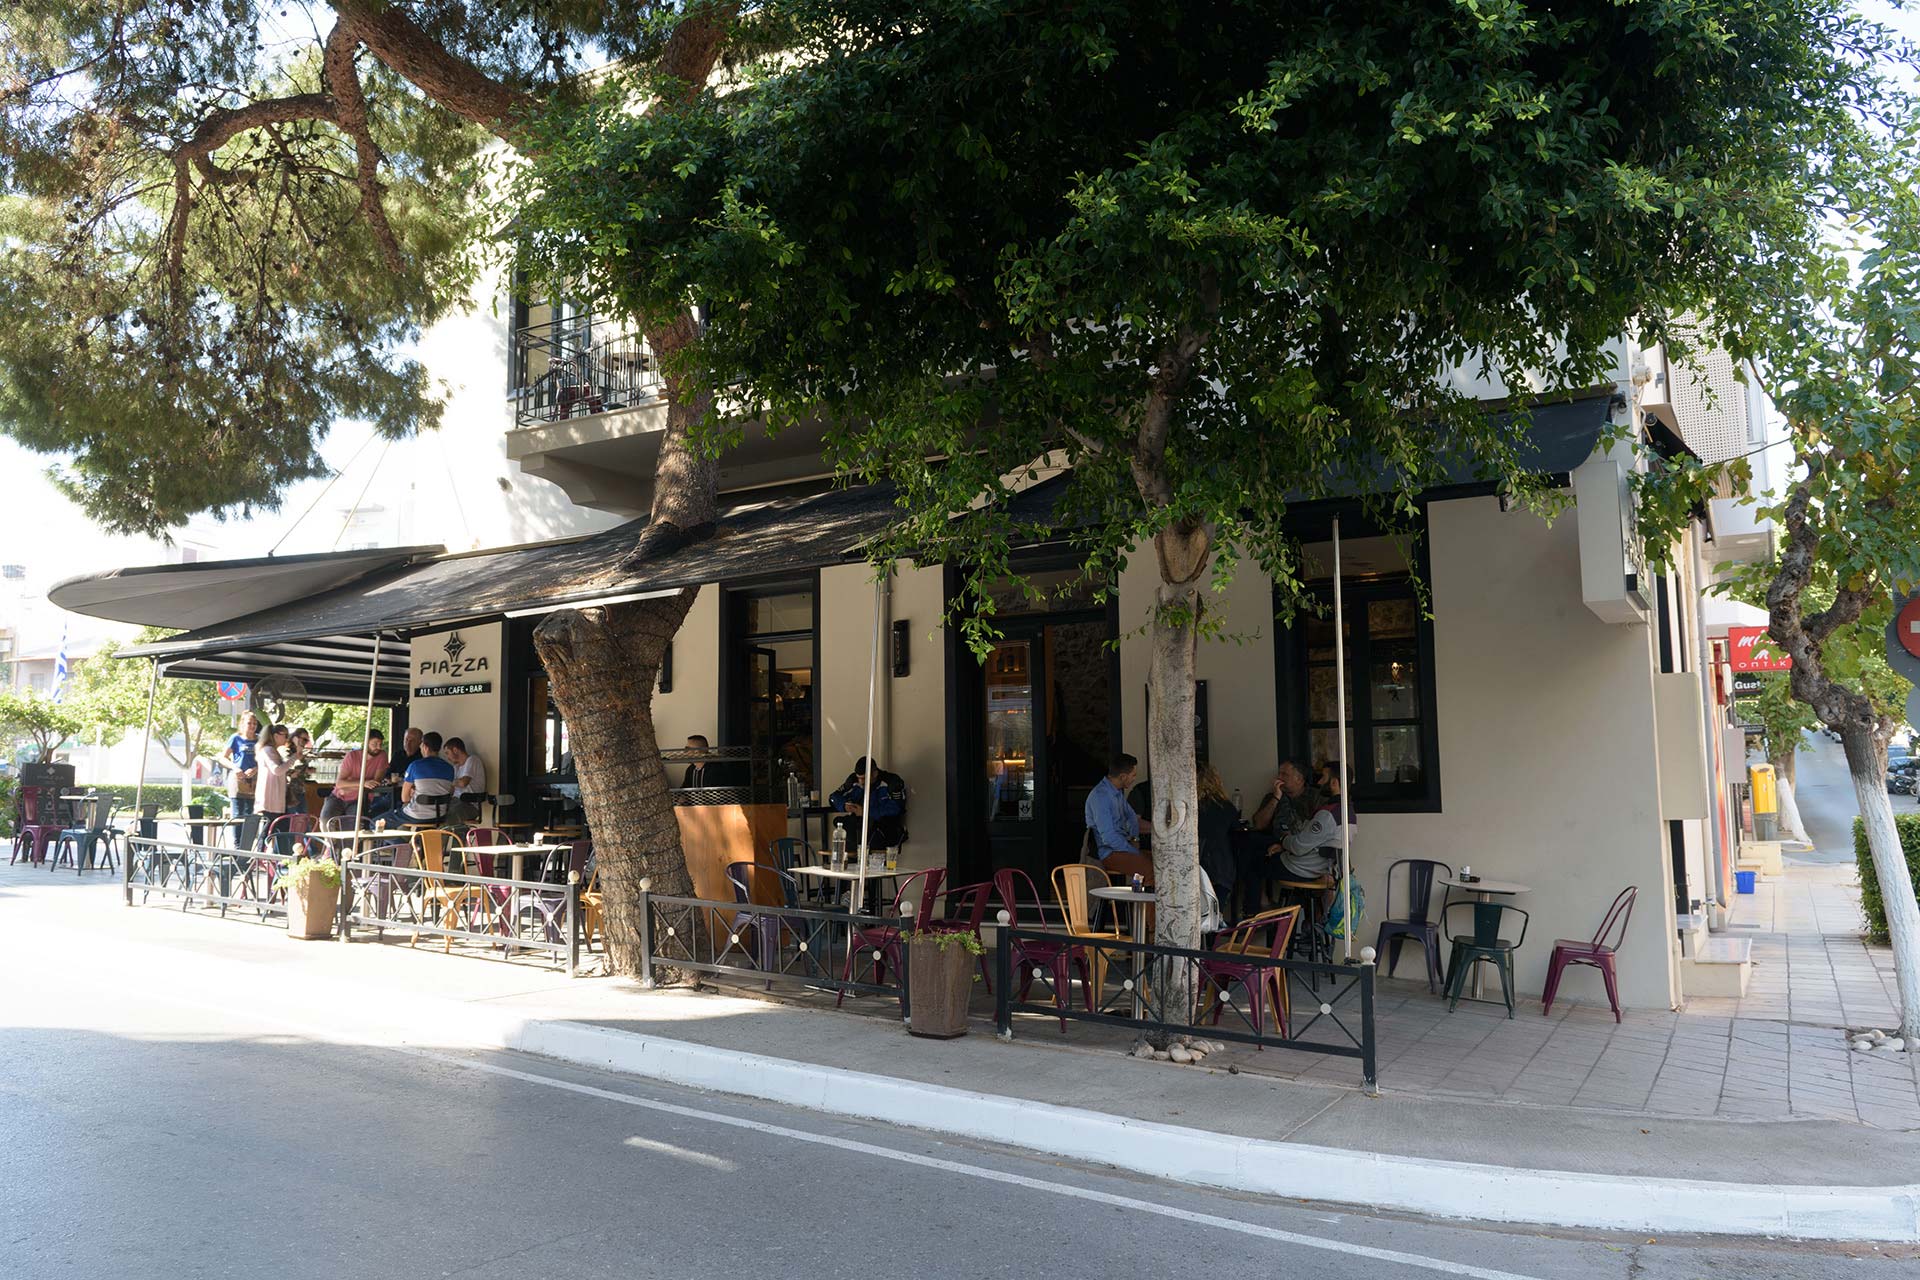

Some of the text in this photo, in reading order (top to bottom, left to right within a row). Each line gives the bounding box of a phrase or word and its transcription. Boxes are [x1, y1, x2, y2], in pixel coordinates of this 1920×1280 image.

[420, 657, 488, 677] PIAZZA
[419, 688, 432, 696] ALL
[433, 687, 447, 695] DAY
[469, 684, 483, 693] BAR
